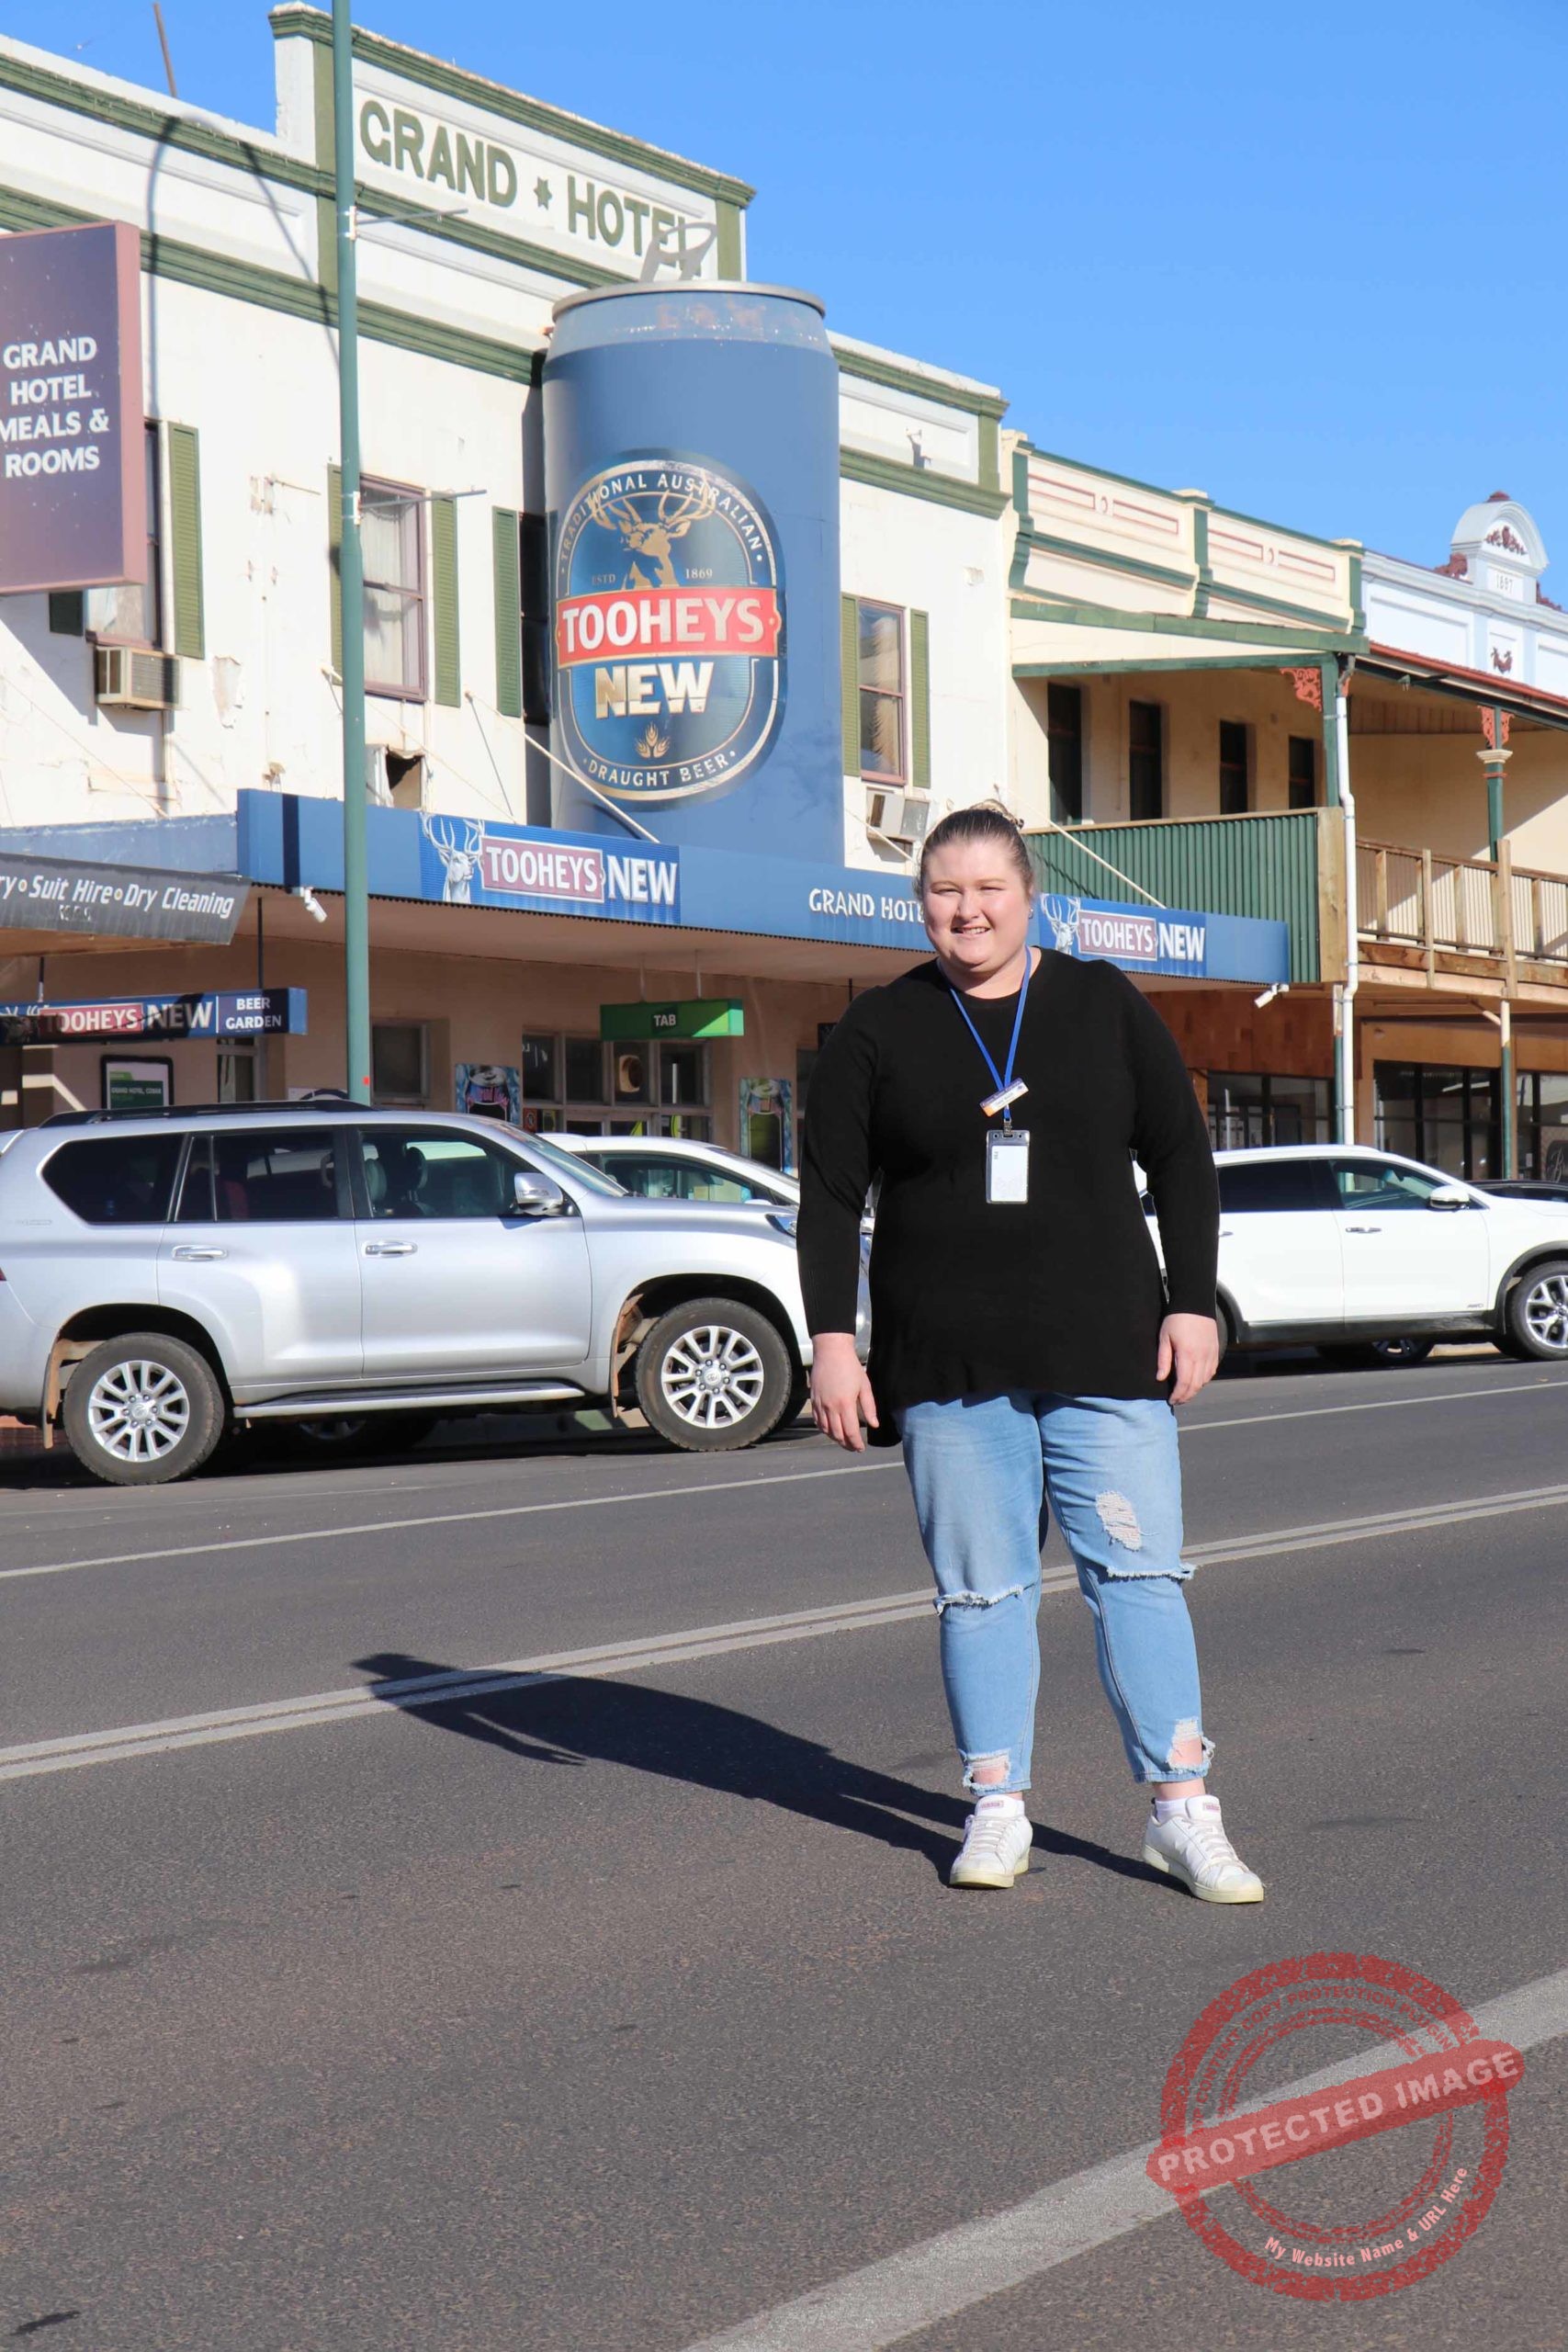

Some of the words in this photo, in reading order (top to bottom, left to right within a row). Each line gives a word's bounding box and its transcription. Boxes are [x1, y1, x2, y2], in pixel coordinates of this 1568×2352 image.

[360, 100, 517, 208] GRAND
[568, 175, 701, 277] HOTEL
[4, 336, 97, 368] GRAND
[10, 374, 92, 405] HOTEL
[0, 411, 82, 442] MEALS
[89, 408, 109, 433] &
[6, 446, 100, 478] ROOMS
[657, 473, 762, 550] AUSTRALIAN
[685, 568, 713, 580] 1869
[562, 597, 764, 653] TOOHEYS
[594, 662, 715, 718] NEW
[588, 759, 670, 786] DRAUGHT
[679, 753, 728, 782] BEER
[486, 845, 597, 893] TOOHEYS
[606, 854, 678, 906] NEW
[28, 874, 69, 901] Suit
[72, 879, 116, 904] Hire
[122, 883, 157, 912] Dry
[162, 887, 235, 919] Cleaning
[808, 888, 874, 918] GRAND
[881, 897, 925, 923] HOTE
[1081, 918, 1153, 953] TOOHEYS
[1159, 922, 1205, 962] NEW
[146, 1001, 213, 1030] NEW
[236, 997, 271, 1011] BEER
[653, 1013, 677, 1027] TAB
[225, 1015, 282, 1030] GARDEN
